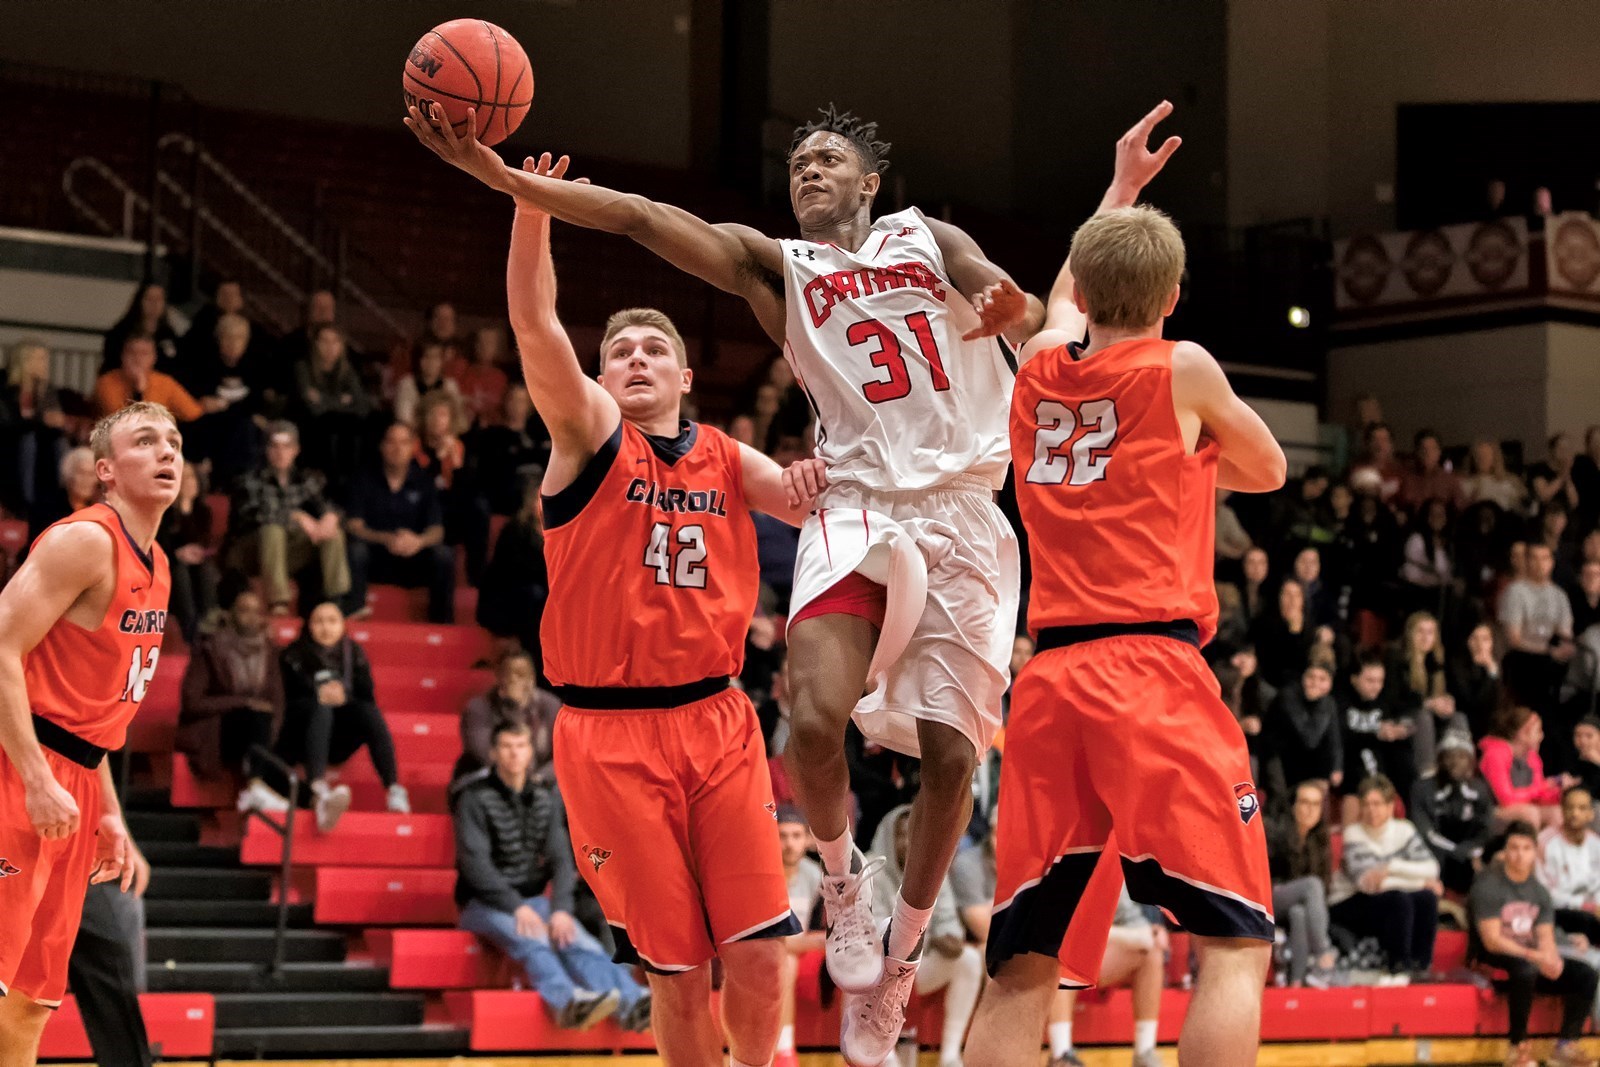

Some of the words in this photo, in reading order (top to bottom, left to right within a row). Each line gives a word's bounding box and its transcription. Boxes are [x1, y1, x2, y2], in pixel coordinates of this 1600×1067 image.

[846, 310, 950, 404] 31
[1025, 397, 1119, 487] 22
[625, 476, 728, 518] CARROLL
[642, 521, 708, 589] 42
[119, 645, 160, 703] 12
